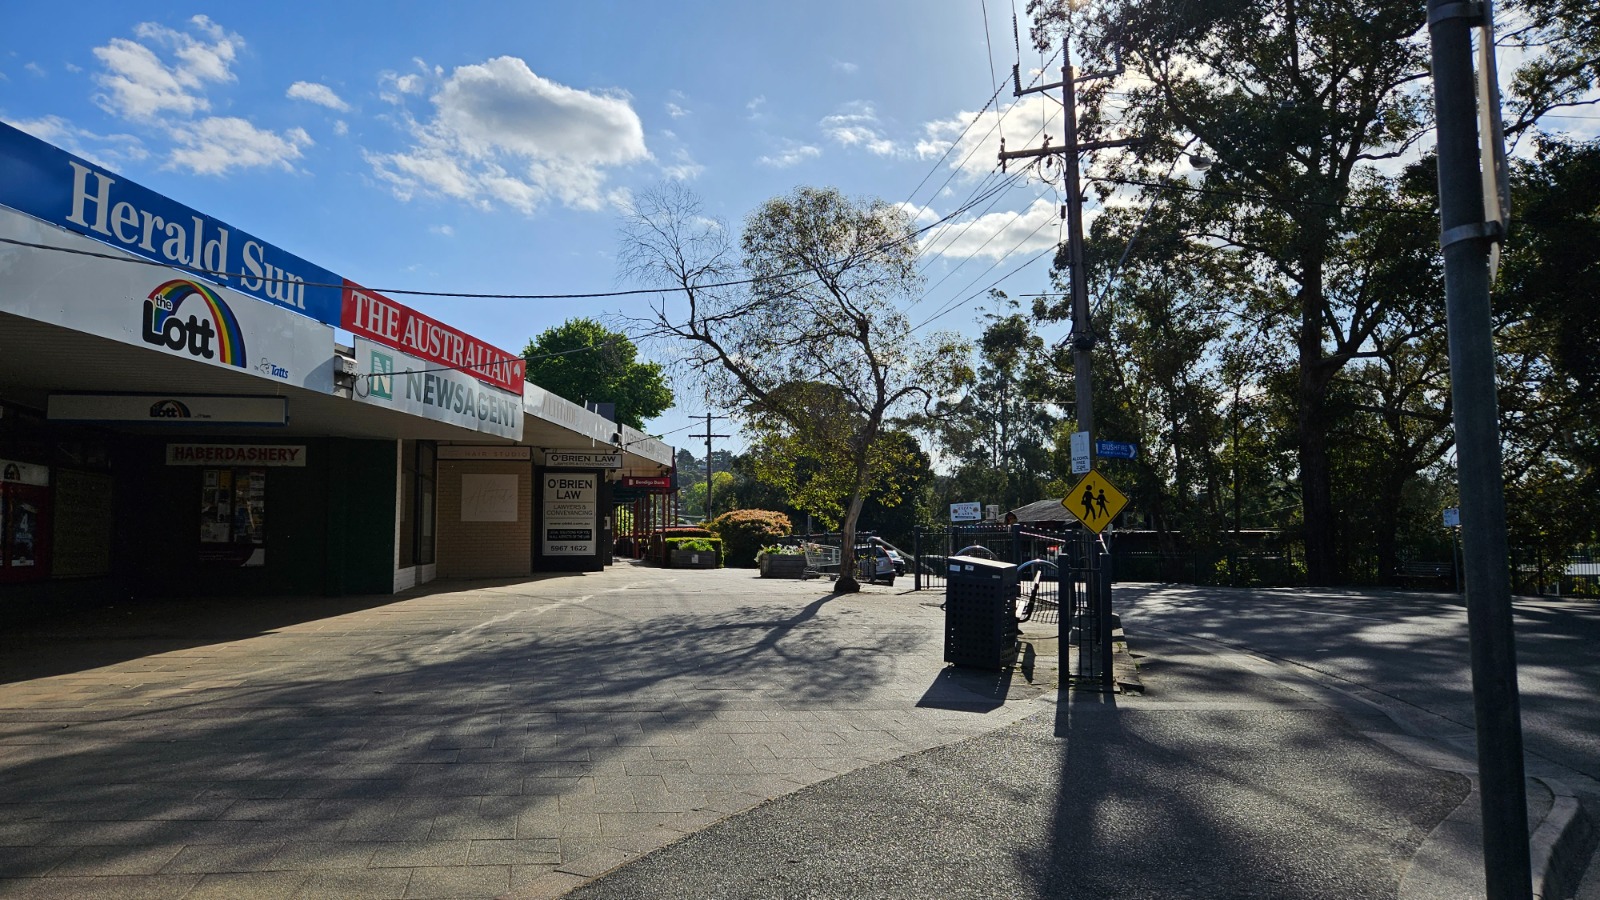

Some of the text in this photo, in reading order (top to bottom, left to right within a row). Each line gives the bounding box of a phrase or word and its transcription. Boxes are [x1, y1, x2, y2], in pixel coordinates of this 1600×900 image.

[66, 161, 306, 310] Herald Sun
[155, 294, 172, 310] the
[142, 300, 215, 359] Lott
[351, 290, 515, 385] THE AUSTRALIAN
[271, 364, 289, 379] Tatts
[405, 367, 517, 428] NEWSAGENT
[174, 446, 300, 461] HABERDASHERY
[551, 454, 591, 462] O'BRIEN
[547, 479, 593, 489] O'BRIEN
[556, 489, 581, 500] LAW
